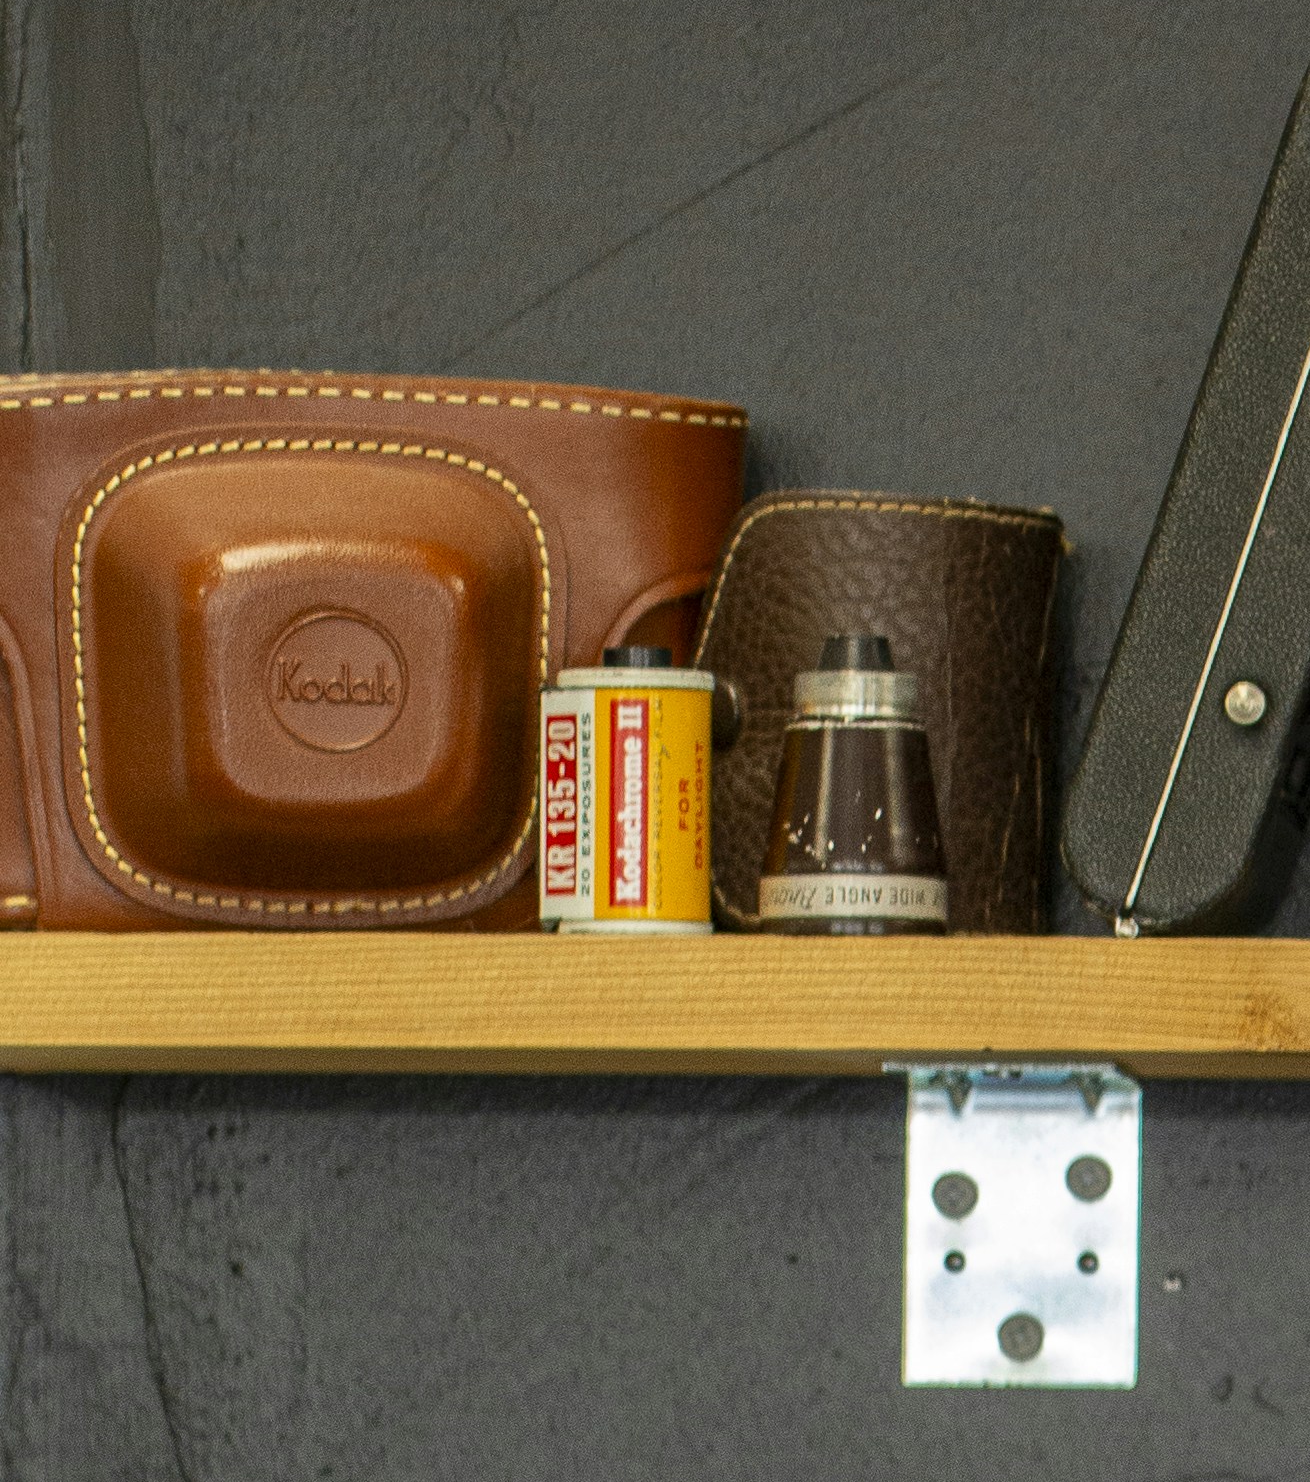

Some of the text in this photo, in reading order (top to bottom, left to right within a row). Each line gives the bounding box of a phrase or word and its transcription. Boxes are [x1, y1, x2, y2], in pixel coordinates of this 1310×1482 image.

[276, 656, 395, 705] Kodak
[548, 718, 575, 891] KR 135-20
[581, 712, 591, 896] 20 EXPOSURES
[615, 705, 643, 902] Kodachrome II
[679, 778, 689, 831] FOR
[694, 742, 704, 870] DAYLIGHT
[825, 886, 883, 905] ANGLE
